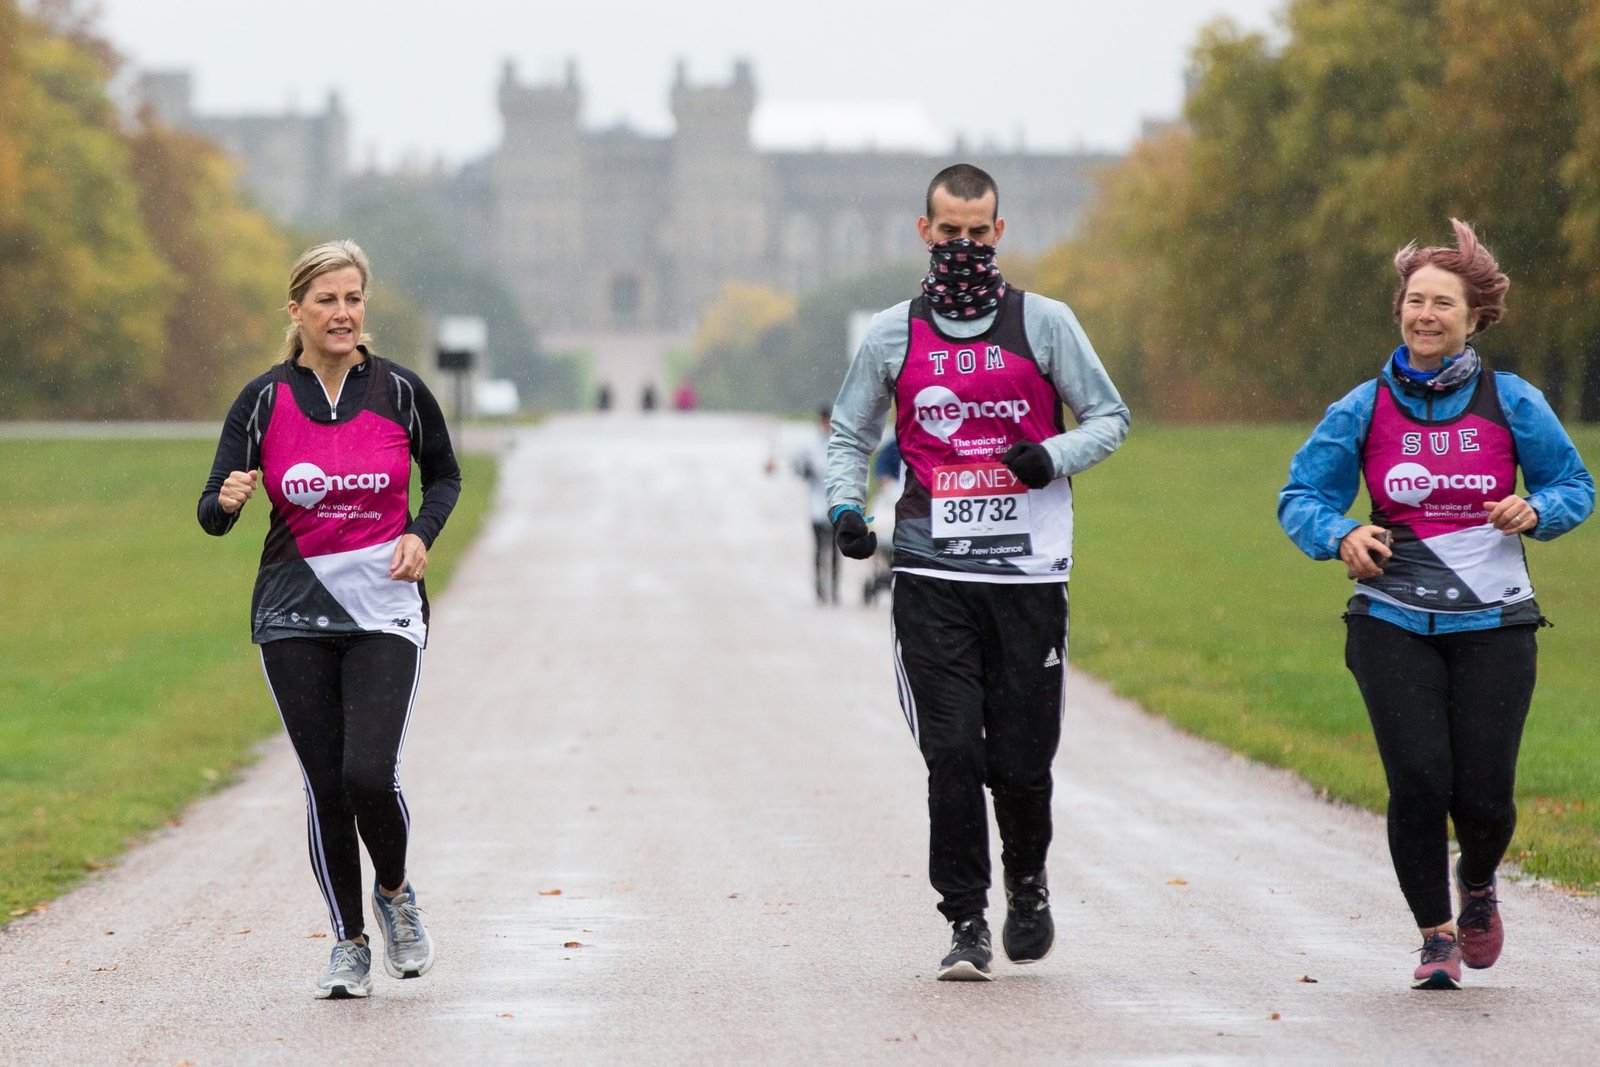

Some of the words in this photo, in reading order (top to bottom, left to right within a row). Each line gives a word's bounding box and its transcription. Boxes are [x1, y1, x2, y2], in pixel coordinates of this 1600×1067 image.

[929, 345, 1005, 375] TOM
[917, 399, 1031, 424] mencap
[953, 438, 970, 447] The
[971, 436, 996, 446] voice
[997, 434, 1007, 445] of
[1402, 428, 1480, 456] SUE
[284, 472, 390, 495] mencap
[1388, 474, 1497, 494] mencap
[317, 510, 347, 521] learning
[348, 510, 382, 521] disability
[332, 502, 352, 511] voice
[943, 497, 1018, 524] 38732
[1424, 502, 1439, 510] The
[1440, 501, 1462, 511] voice
[1462, 501, 1472, 511] of
[990, 545, 1023, 555] balance
